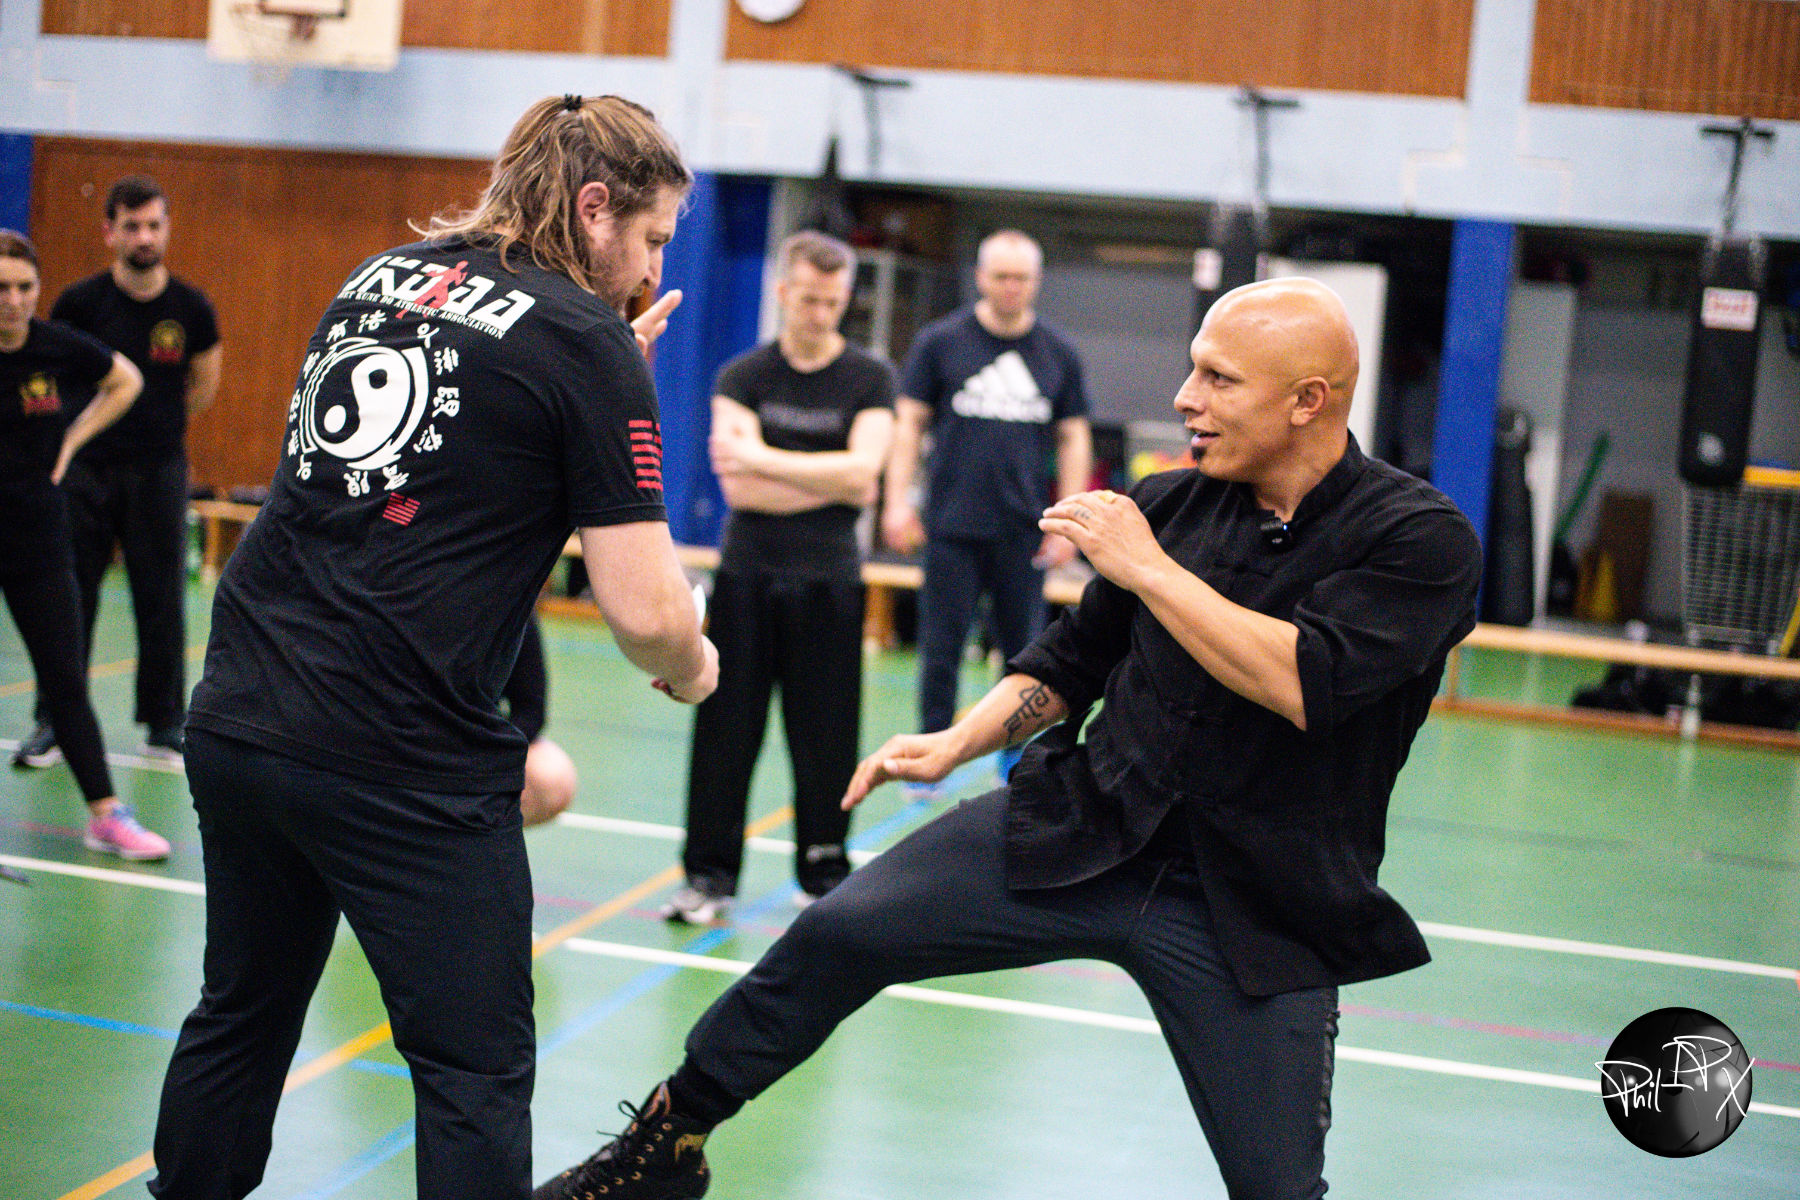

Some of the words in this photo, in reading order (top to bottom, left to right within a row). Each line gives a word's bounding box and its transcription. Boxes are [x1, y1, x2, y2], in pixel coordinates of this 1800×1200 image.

[355, 292, 382, 303] KUNE
[380, 295, 396, 305] DO
[394, 299, 440, 318] ATHLETIC
[438, 310, 505, 340] ASSOCIATION
